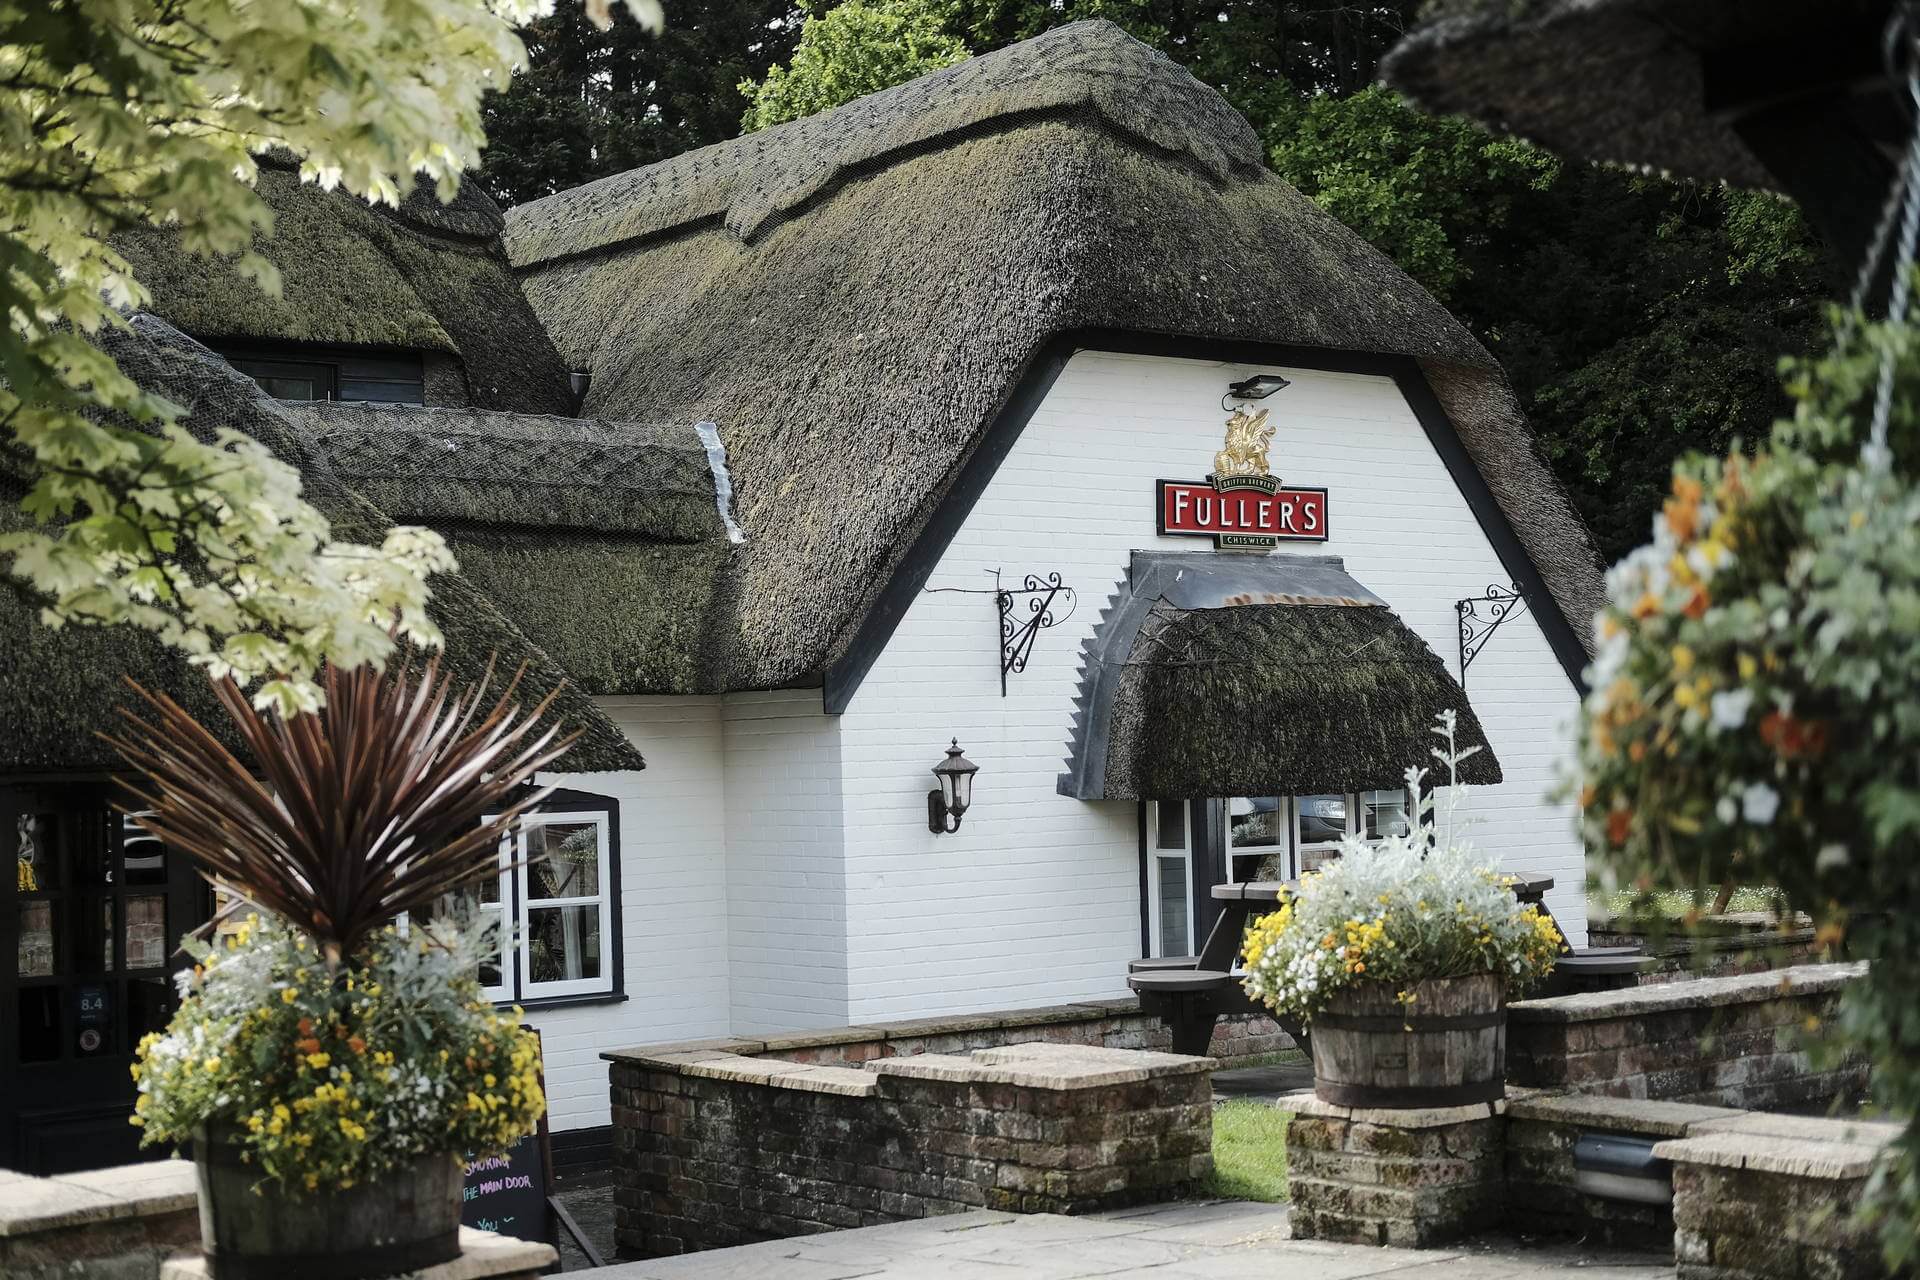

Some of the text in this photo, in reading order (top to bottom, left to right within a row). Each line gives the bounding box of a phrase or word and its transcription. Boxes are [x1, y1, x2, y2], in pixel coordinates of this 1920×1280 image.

[1175, 490, 1317, 532] FULLER'S
[1227, 536, 1271, 545] CHISWICK
[81, 998, 103, 1011] 8.4
[480, 1179, 503, 1195] MAIN
